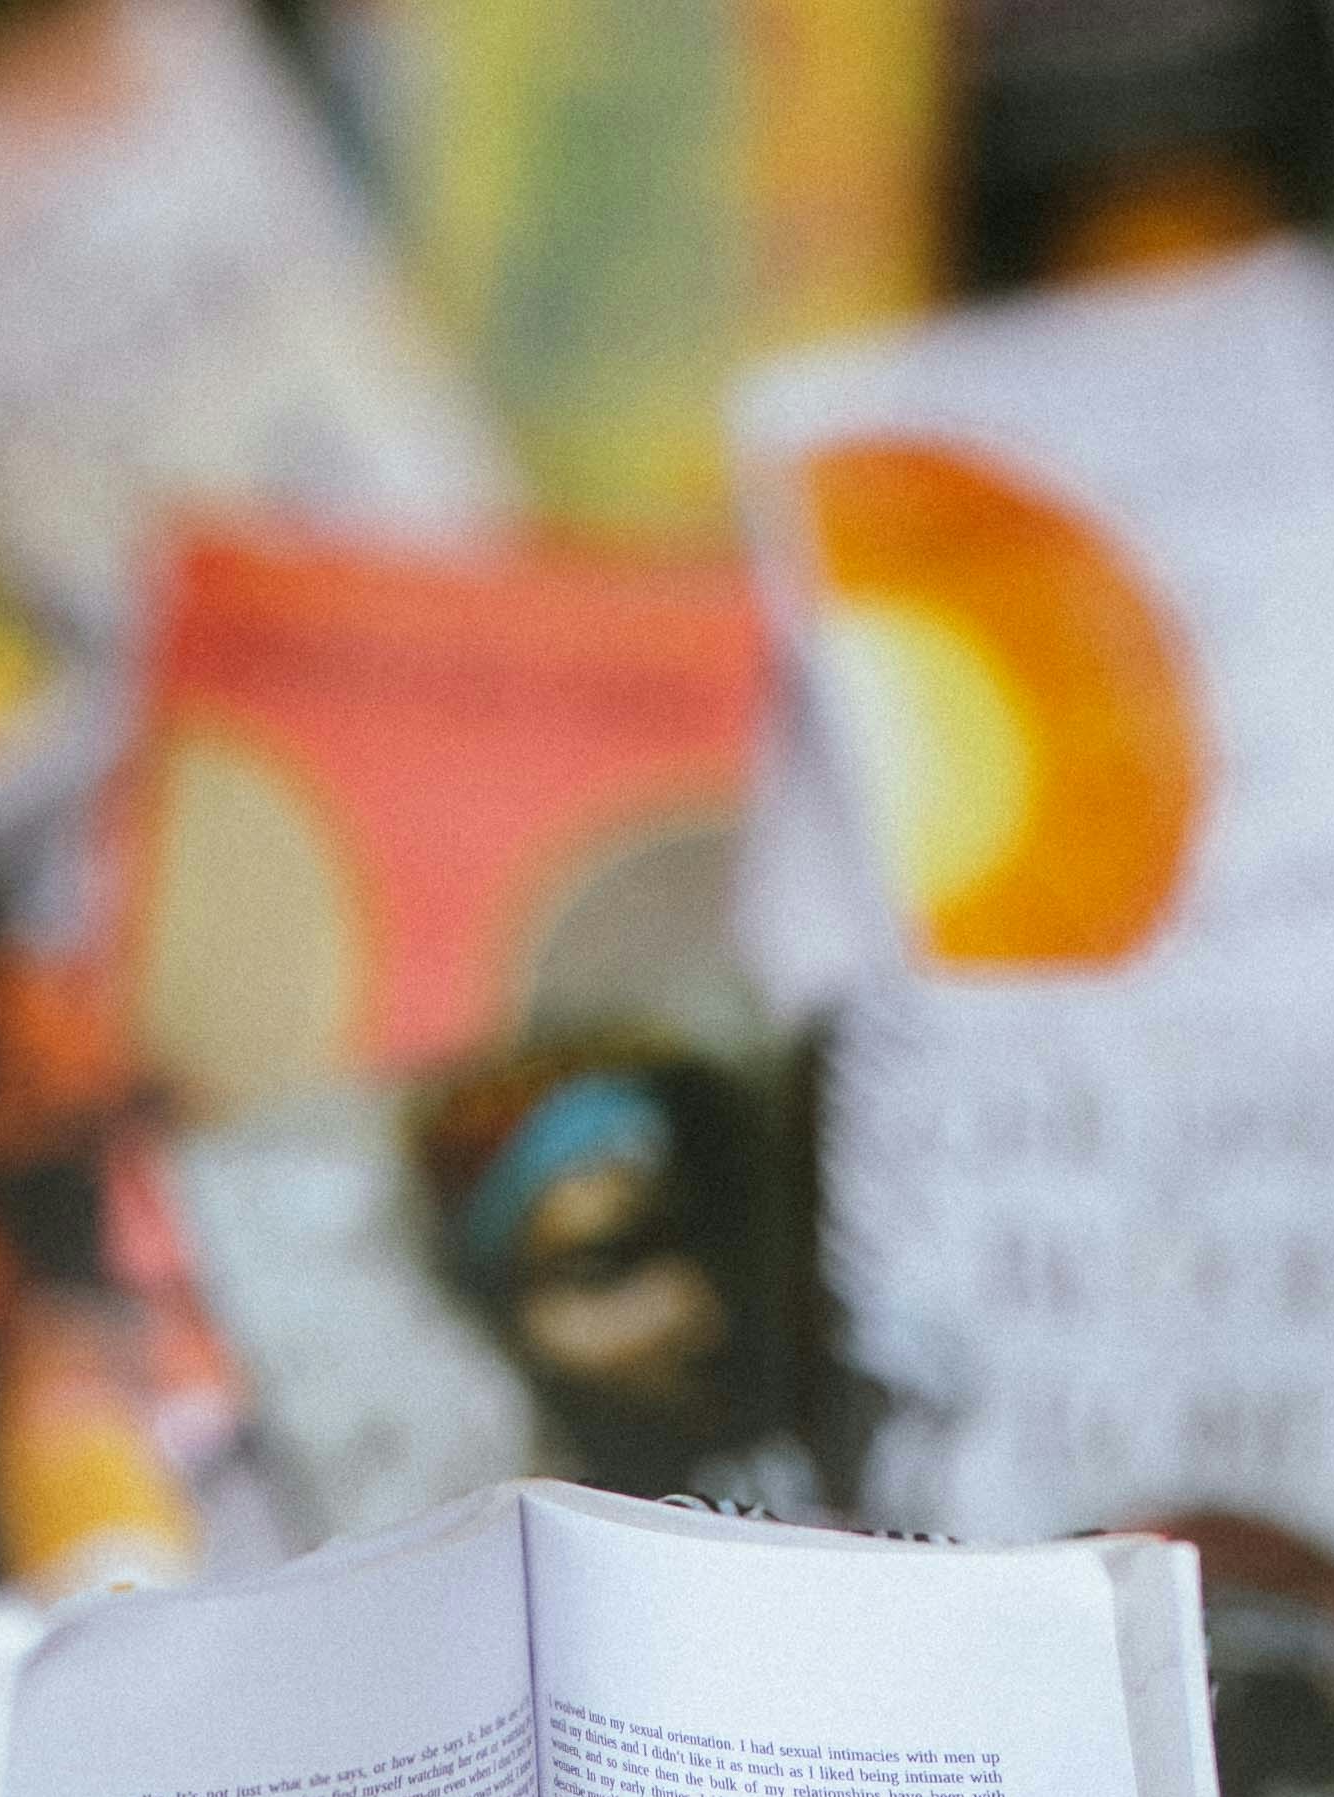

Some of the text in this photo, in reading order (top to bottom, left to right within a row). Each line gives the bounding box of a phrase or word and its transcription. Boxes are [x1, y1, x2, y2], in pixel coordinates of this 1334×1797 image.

[608, 1717, 1001, 1768] my sexual orientation. I had sexual intimacies with men up
[371, 1760, 387, 1775] or
[390, 1753, 416, 1770] how
[585, 1766, 597, 1783] In
[599, 1774, 616, 1792] my
